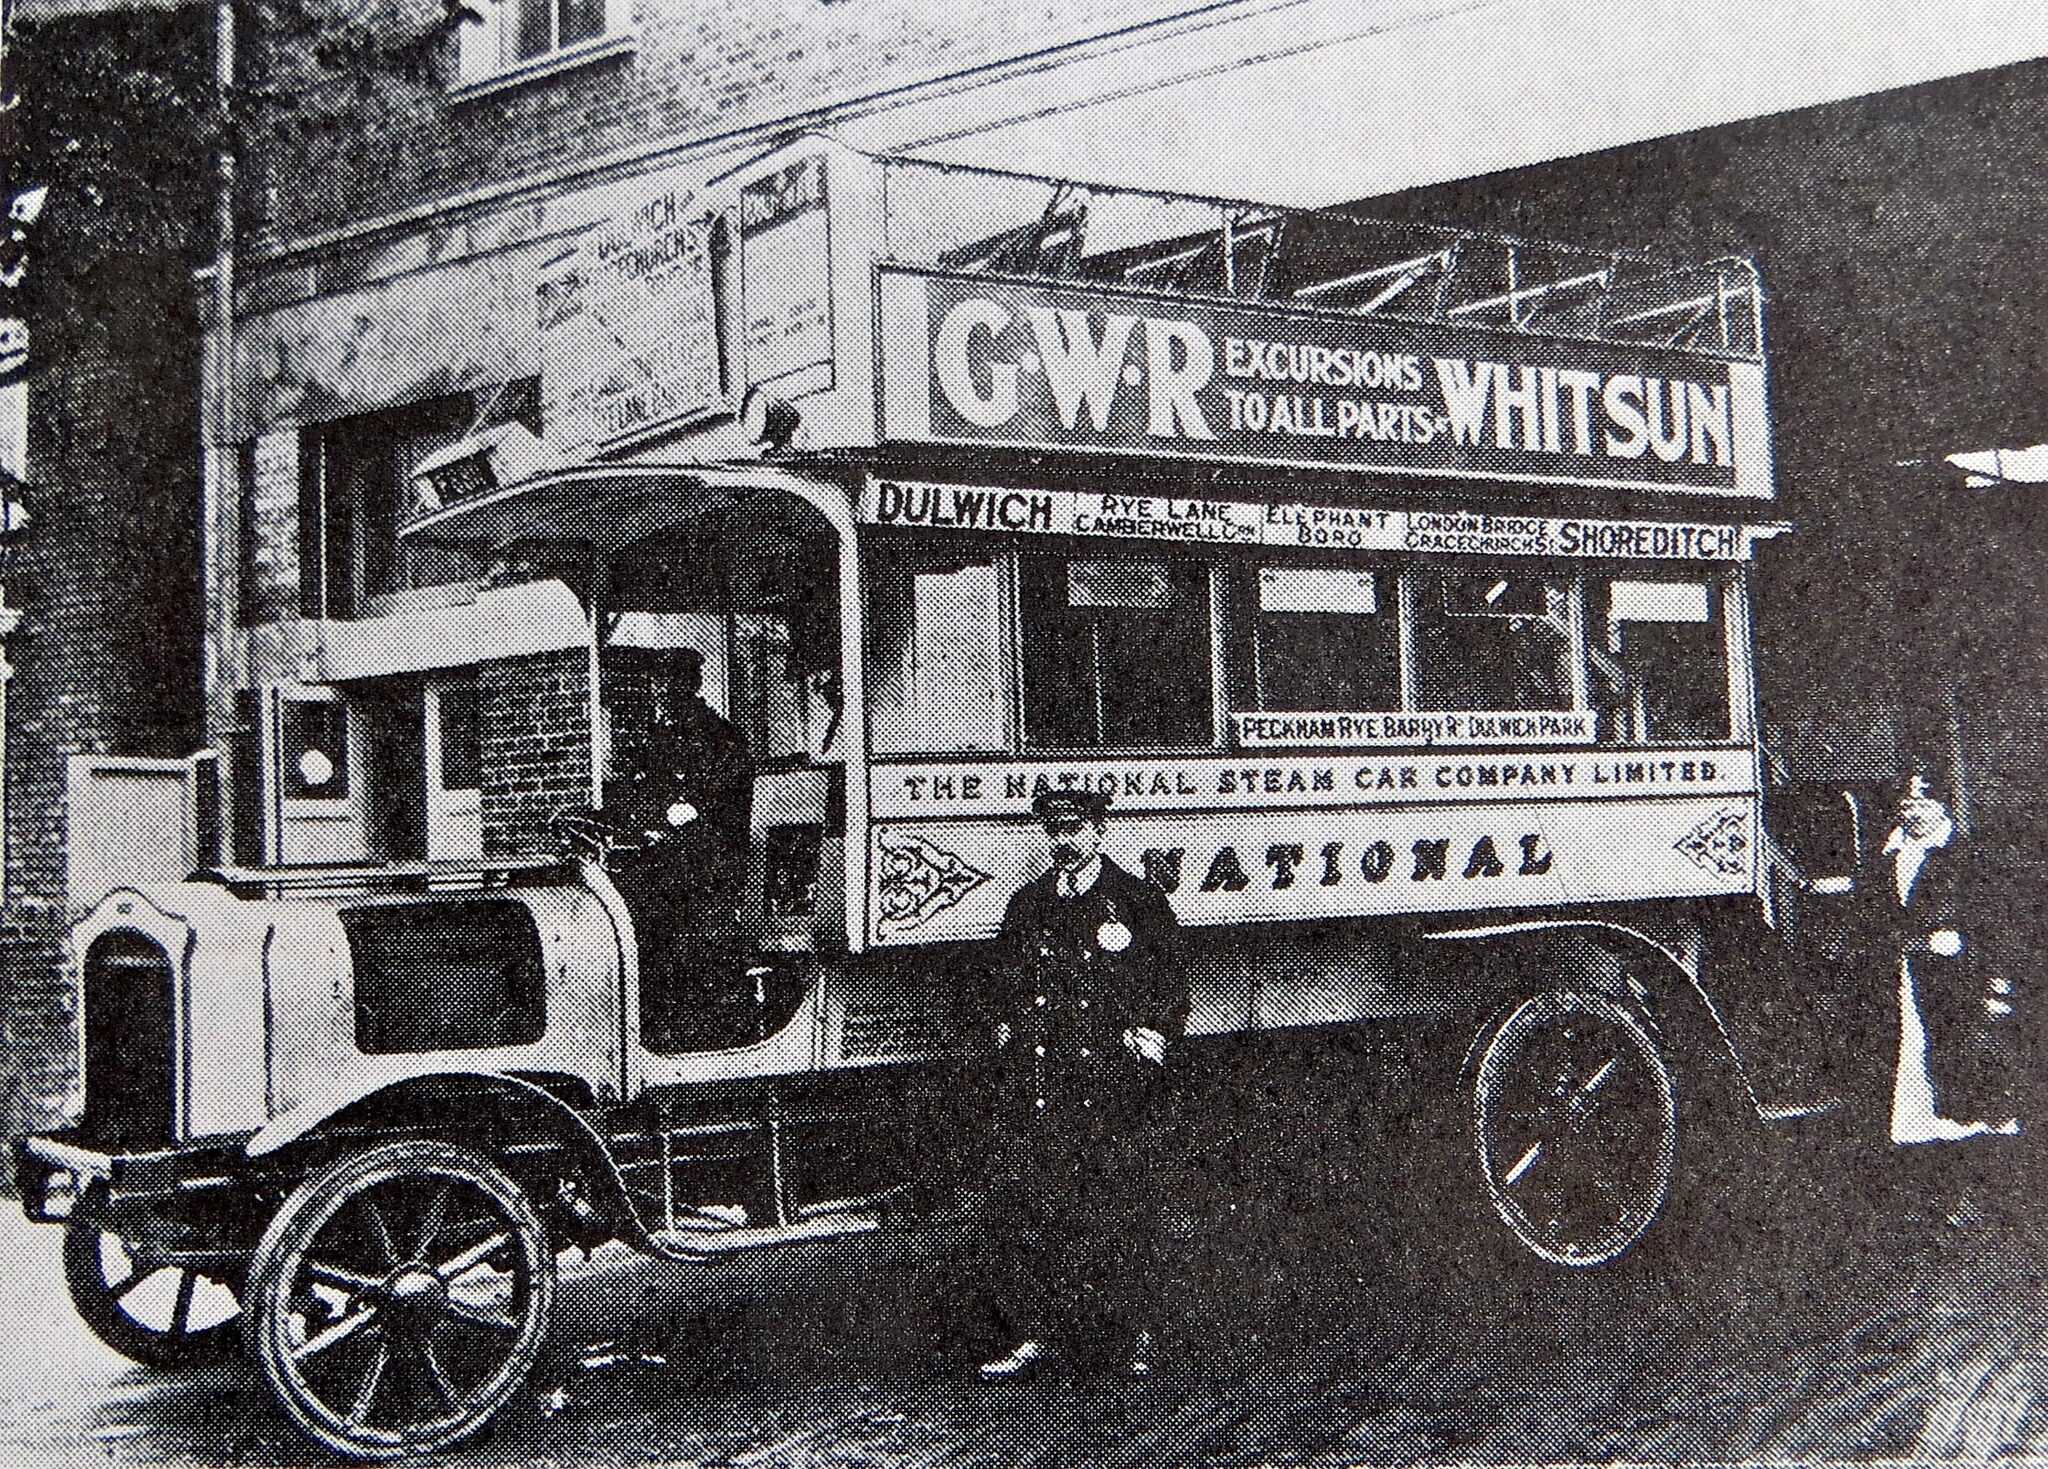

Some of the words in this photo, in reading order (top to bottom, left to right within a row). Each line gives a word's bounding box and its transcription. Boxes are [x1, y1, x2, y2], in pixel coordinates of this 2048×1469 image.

[1226, 336, 1423, 391] EXCURSIONS
[1227, 389, 1268, 432] TO
[1269, 394, 1336, 437] ALL
[1338, 400, 1434, 444] PARTS
[1431, 356, 1734, 466] WHITSUN
[877, 481, 1053, 530] DULWICH
[1101, 493, 1152, 518] RYE
[1167, 498, 1231, 522] LANE
[1266, 502, 1390, 529] ELEPHANT
[1299, 525, 1361, 547] BORO
[1561, 520, 1735, 560] SHOREDITCH
[1242, 715, 1335, 740] PECKHAM
[1338, 715, 1379, 739] RYE
[1540, 715, 1587, 737] PARK
[903, 775, 982, 800] THE
[1004, 771, 1198, 799] NATIONAL
[1215, 767, 1337, 795] STEAM
[1354, 766, 1418, 790] CAR
[1435, 763, 1577, 788] COMPANY
[1139, 832, 1553, 896] NATIONAL
